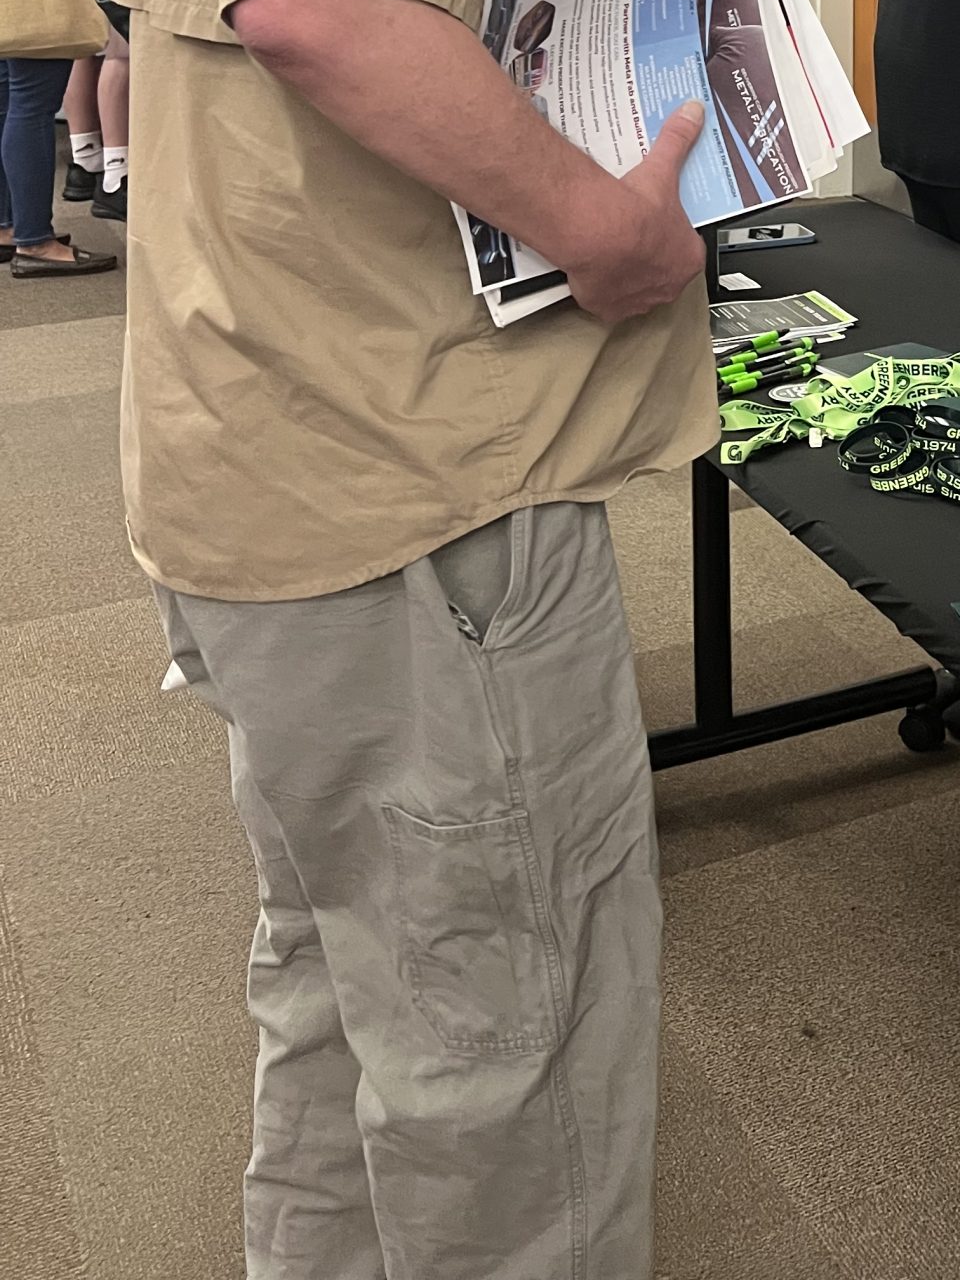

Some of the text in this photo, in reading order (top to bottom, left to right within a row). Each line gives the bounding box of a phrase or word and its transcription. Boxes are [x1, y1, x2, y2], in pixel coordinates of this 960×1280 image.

[626, 80, 635, 96] Fab
[629, 97, 638, 114] and
[632, 116, 643, 139] Build
[730, 69, 793, 194] METAL FABRCATION
[922, 439, 956, 453] 1974
